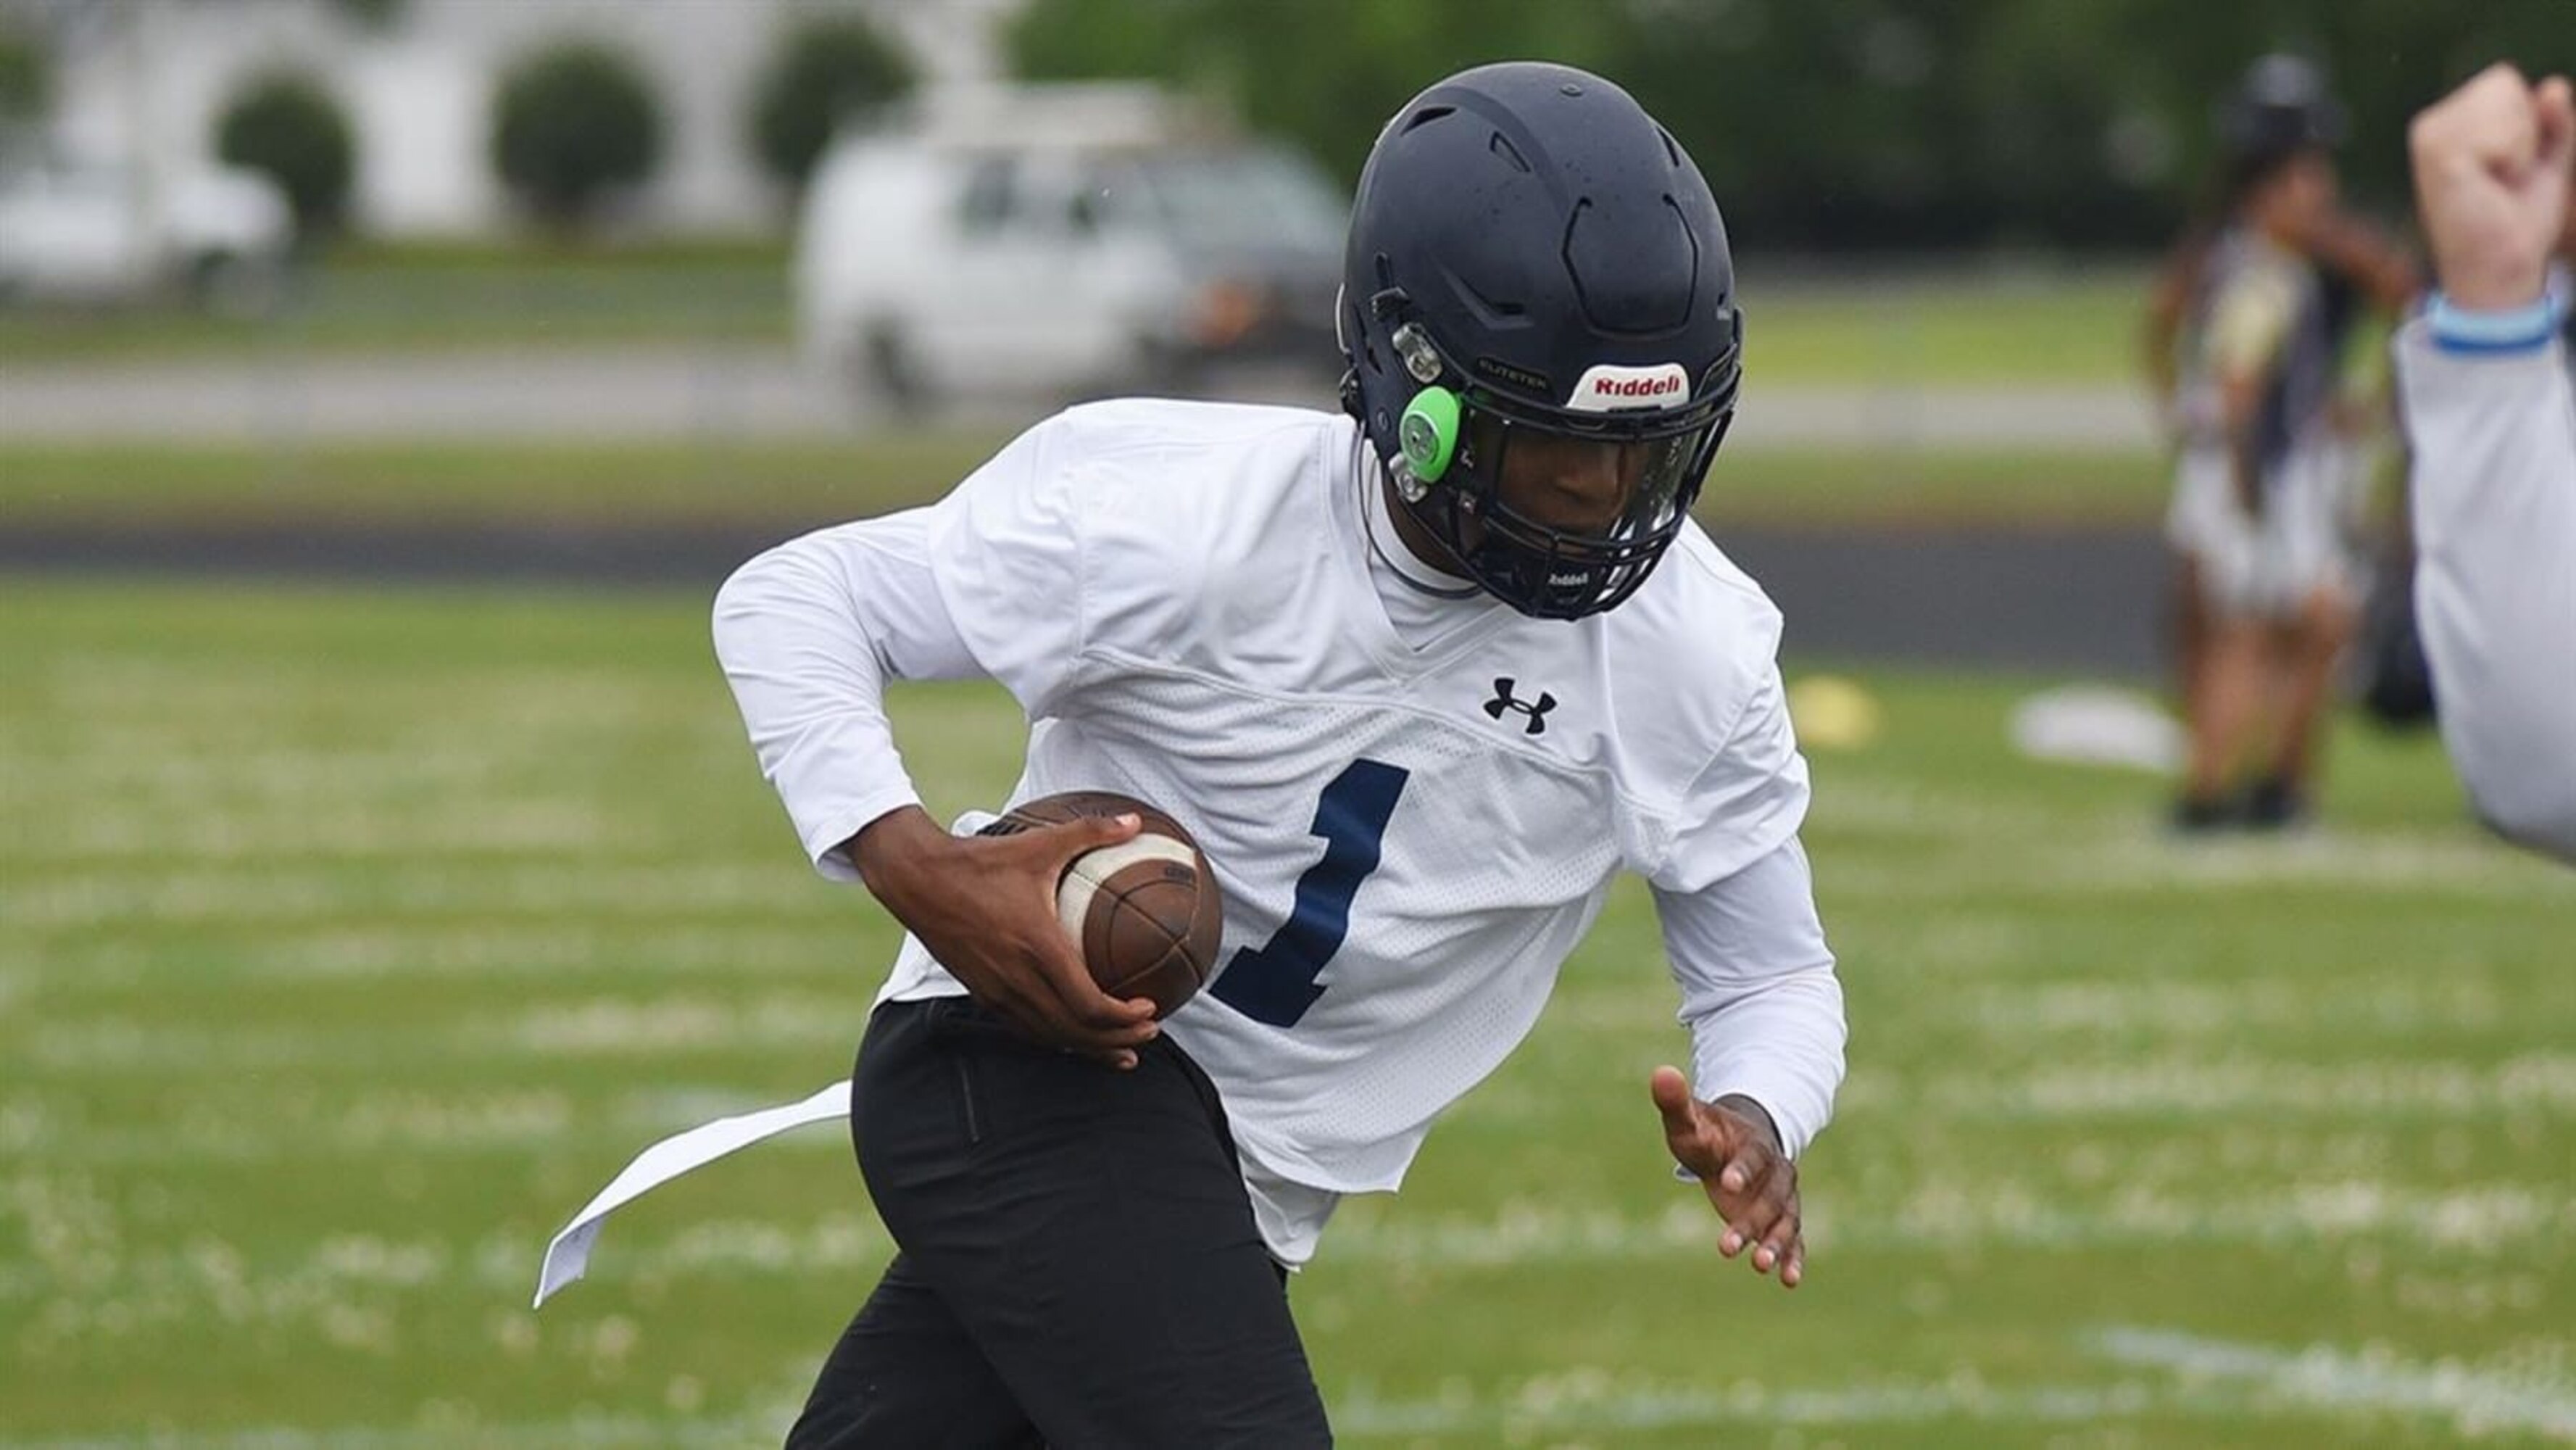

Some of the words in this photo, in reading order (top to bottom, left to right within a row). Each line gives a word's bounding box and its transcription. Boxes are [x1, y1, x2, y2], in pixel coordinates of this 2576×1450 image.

[1595, 376, 1680, 396] Riddell
[1549, 572, 1588, 585] Riddell
[1209, 758, 1410, 1028] 1
